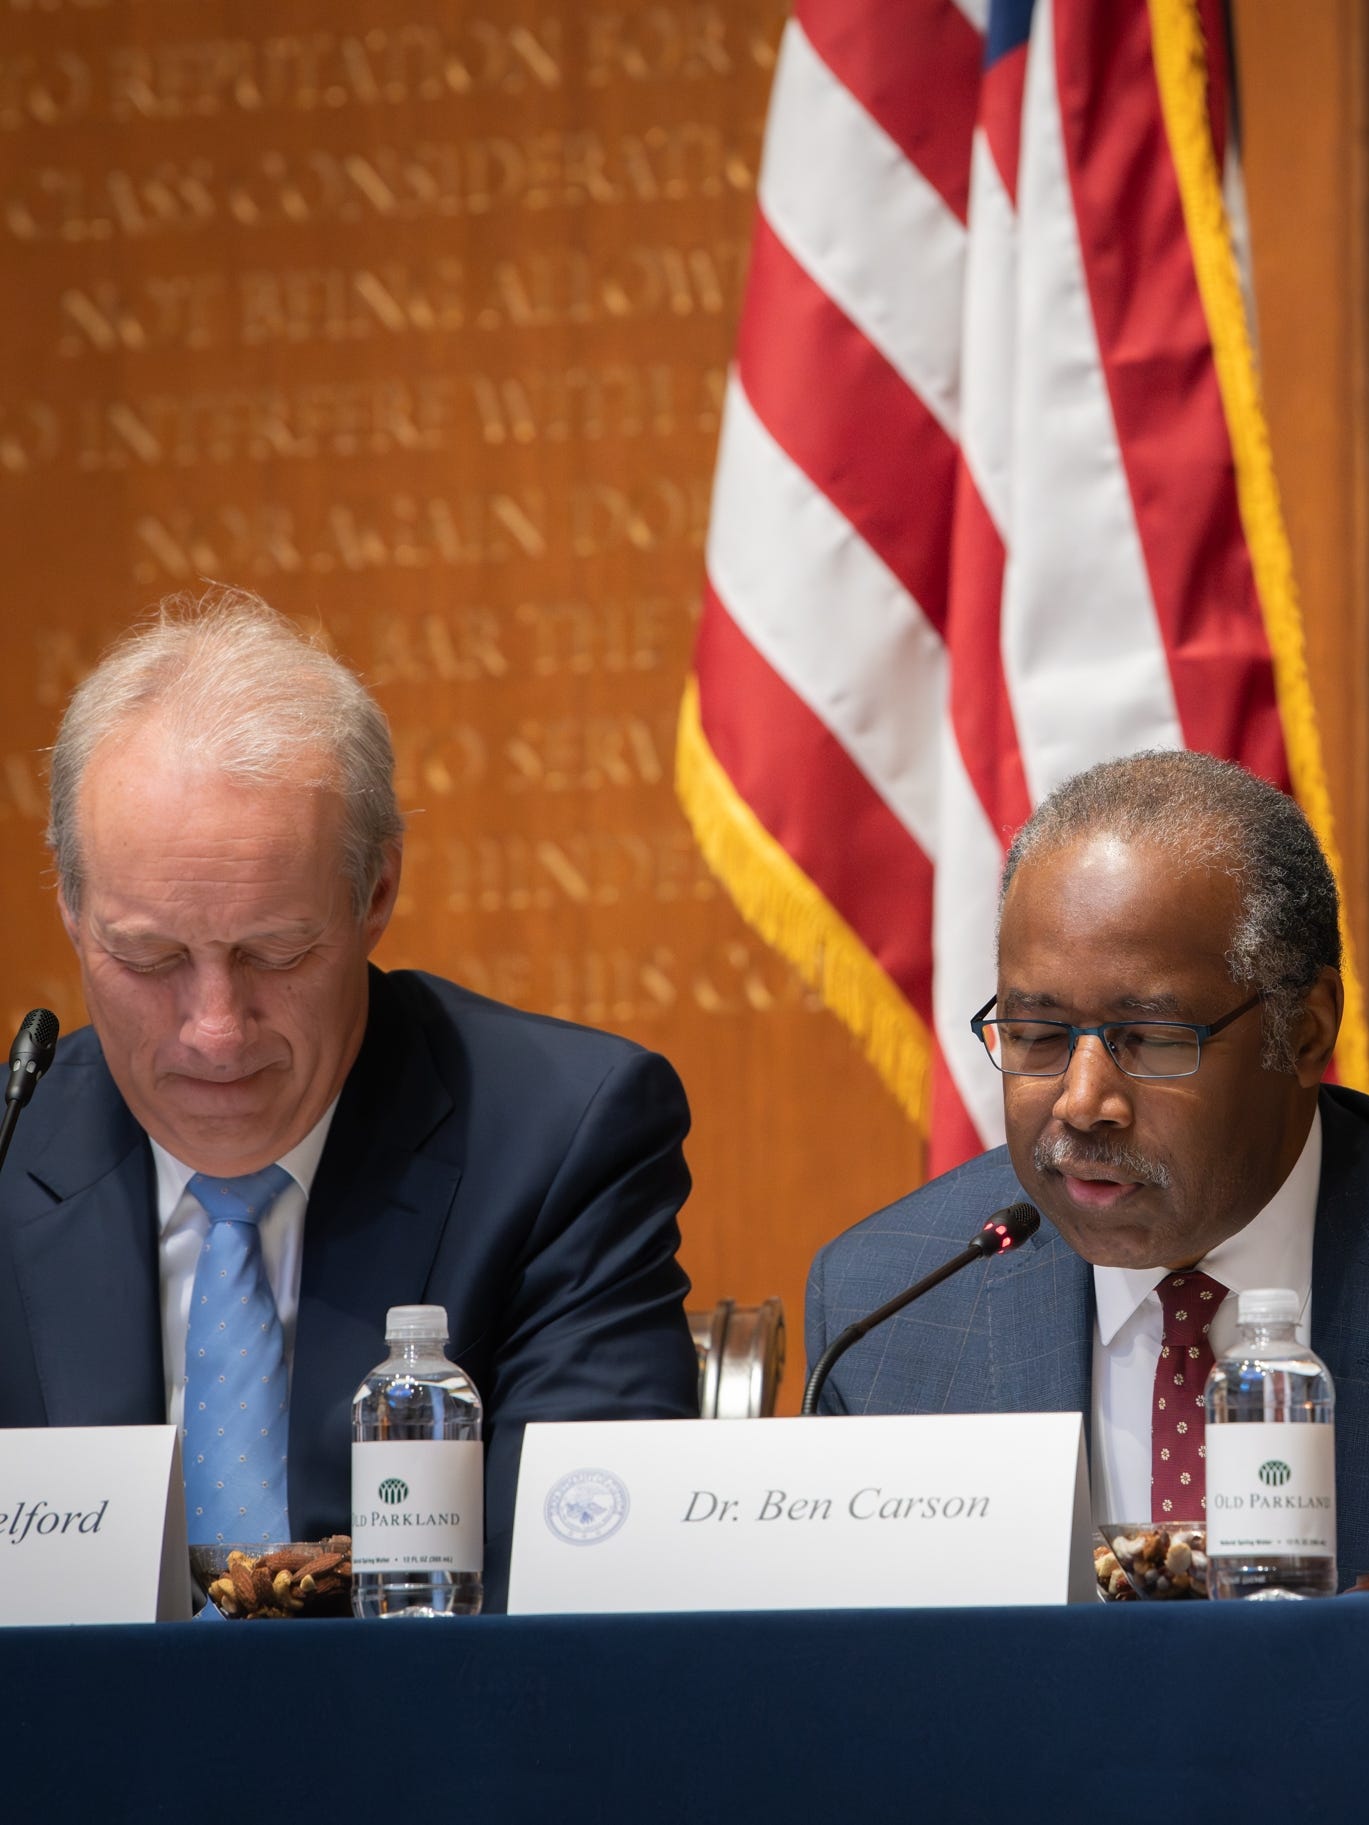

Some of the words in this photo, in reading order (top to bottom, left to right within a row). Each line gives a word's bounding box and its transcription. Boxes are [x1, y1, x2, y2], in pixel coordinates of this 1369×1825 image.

[682, 1489, 740, 1523] Dr.
[758, 1488, 832, 1522] Ben
[848, 1486, 991, 1520] Carson
[1214, 1493, 1244, 1509] OLD
[371, 1511, 461, 1527] PARKLAND
